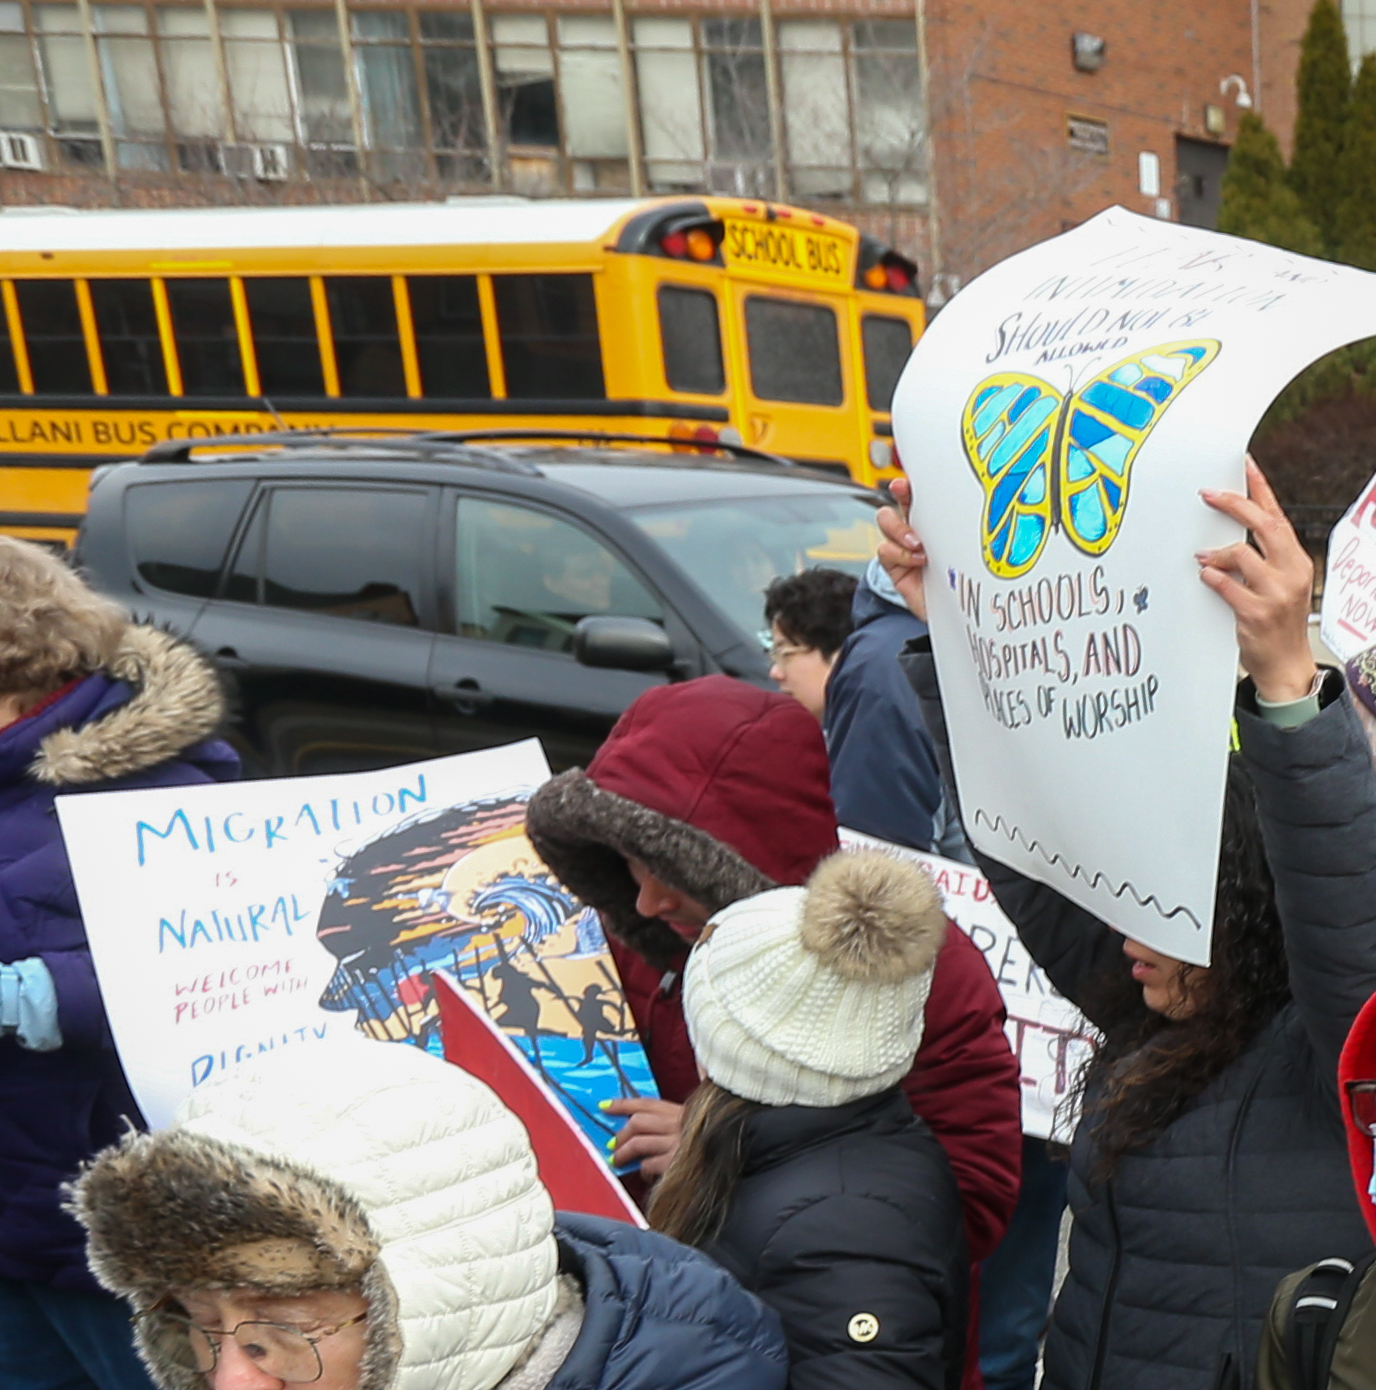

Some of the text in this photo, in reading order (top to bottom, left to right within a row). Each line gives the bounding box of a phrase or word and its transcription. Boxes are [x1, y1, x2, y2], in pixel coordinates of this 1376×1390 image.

[728, 225, 840, 274] SCHOOL BUS
[985, 306, 1109, 364] SHOULD
[1033, 335, 1129, 366] ALLOWED
[94, 420, 157, 446] BUS
[958, 571, 981, 628] IN
[1082, 622, 1142, 678] AND
[1036, 683, 1058, 719] OF
[1062, 673, 1160, 740] WORSHIP
[135, 773, 428, 868] MIGRATION
[214, 869, 239, 888] IS
[157, 892, 312, 954] NATURAL
[173, 976, 309, 1025] PEOPLE WITH
[174, 957, 296, 998] WELCOME
